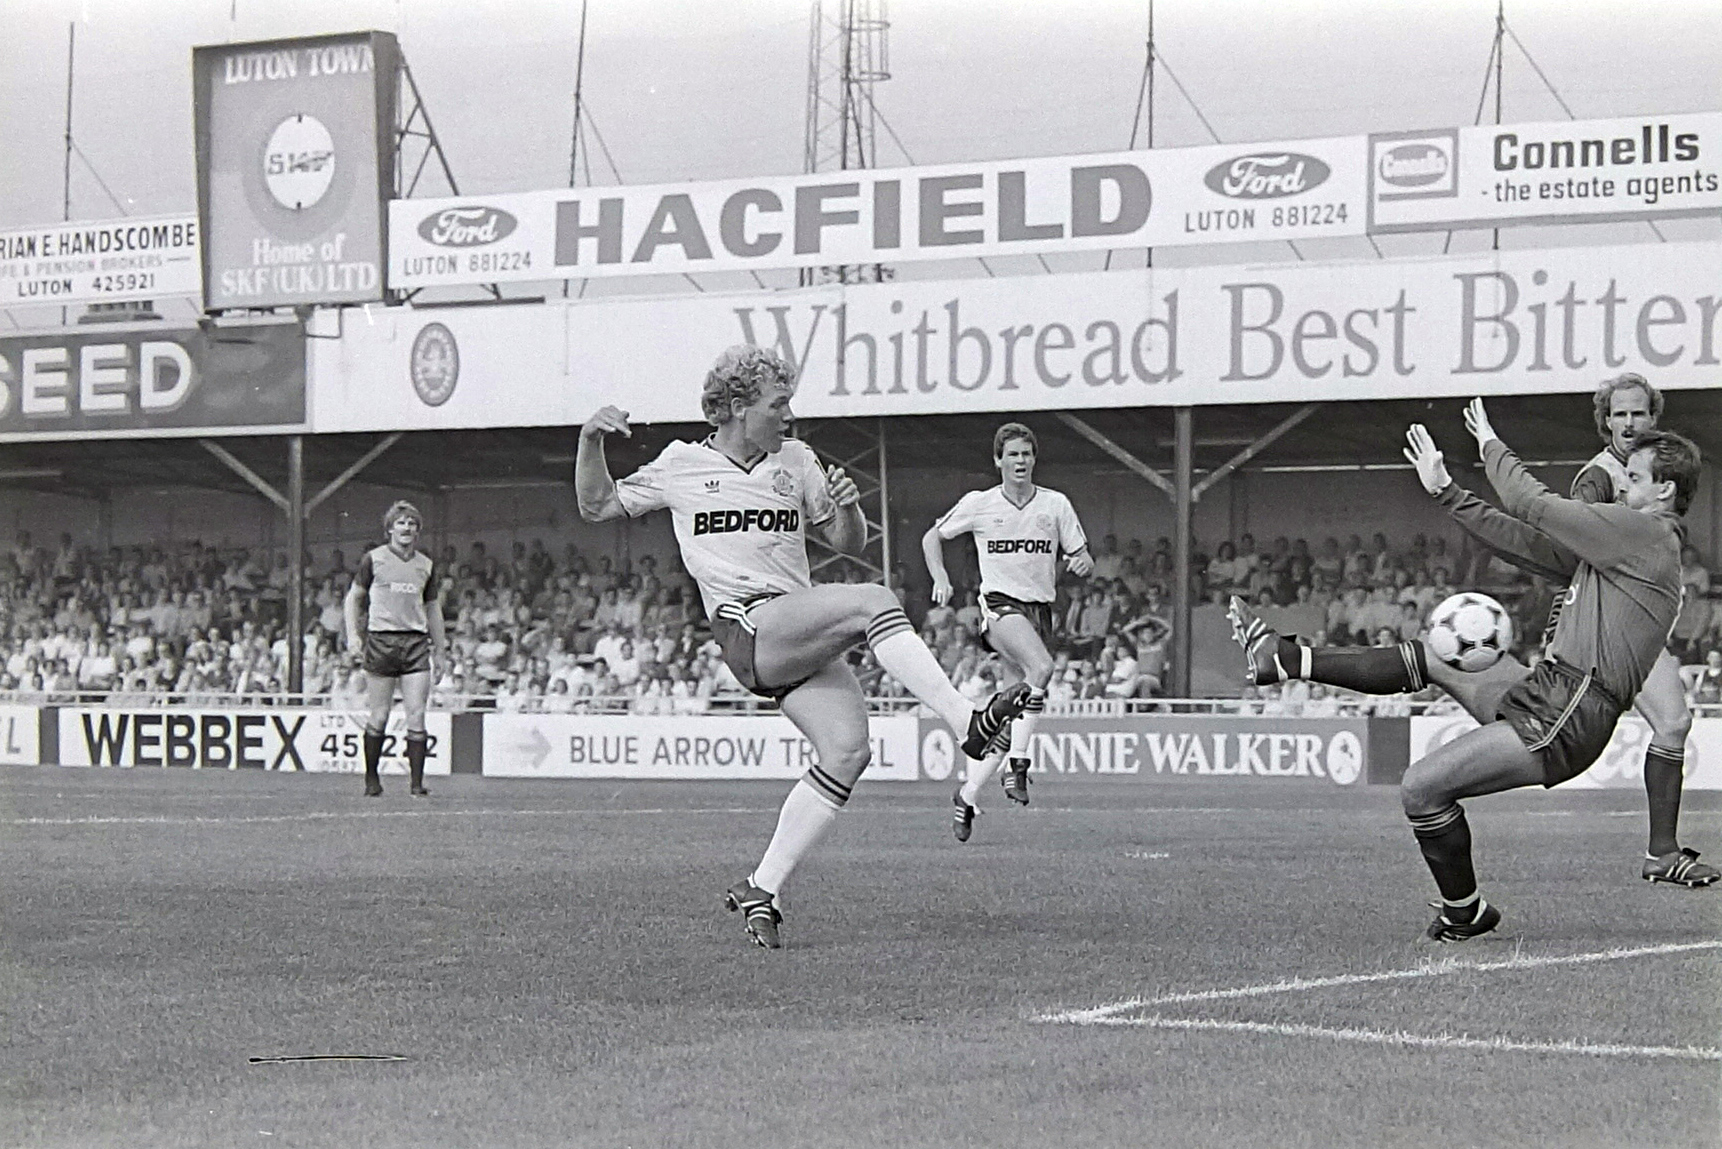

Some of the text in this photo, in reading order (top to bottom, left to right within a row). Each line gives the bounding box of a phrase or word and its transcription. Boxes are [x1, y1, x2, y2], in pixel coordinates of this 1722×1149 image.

[225, 44, 374, 84] LUTON TOWN
[268, 152, 328, 175] SK
[1494, 125, 1700, 172] Connells
[1222, 155, 1306, 196] Ford
[1539, 177, 1615, 200] estate
[1626, 169, 1719, 205] agents
[430, 207, 499, 245] Ford
[554, 163, 1153, 267] HACFIELD
[1185, 203, 1348, 233] LUTON 881224
[59, 223, 195, 255] HANDSCOMBE
[253, 232, 347, 266] Home of
[36, 256, 96, 276] PENSION
[326, 261, 377, 292] LTD
[404, 251, 532, 277] LUTON 881224
[19, 273, 154, 297] LUTON 425921
[1219, 281, 1417, 383] Best
[1451, 269, 1722, 375] Bitter
[0, 341, 194, 415] EED
[694, 508, 799, 536] BEDFORD
[82, 713, 307, 771] WEBBEX
[320, 734, 438, 758] 4522
[570, 735, 638, 765] BLUE
[652, 736, 766, 767] ARROW
[1145, 732, 1327, 777] WALKER
